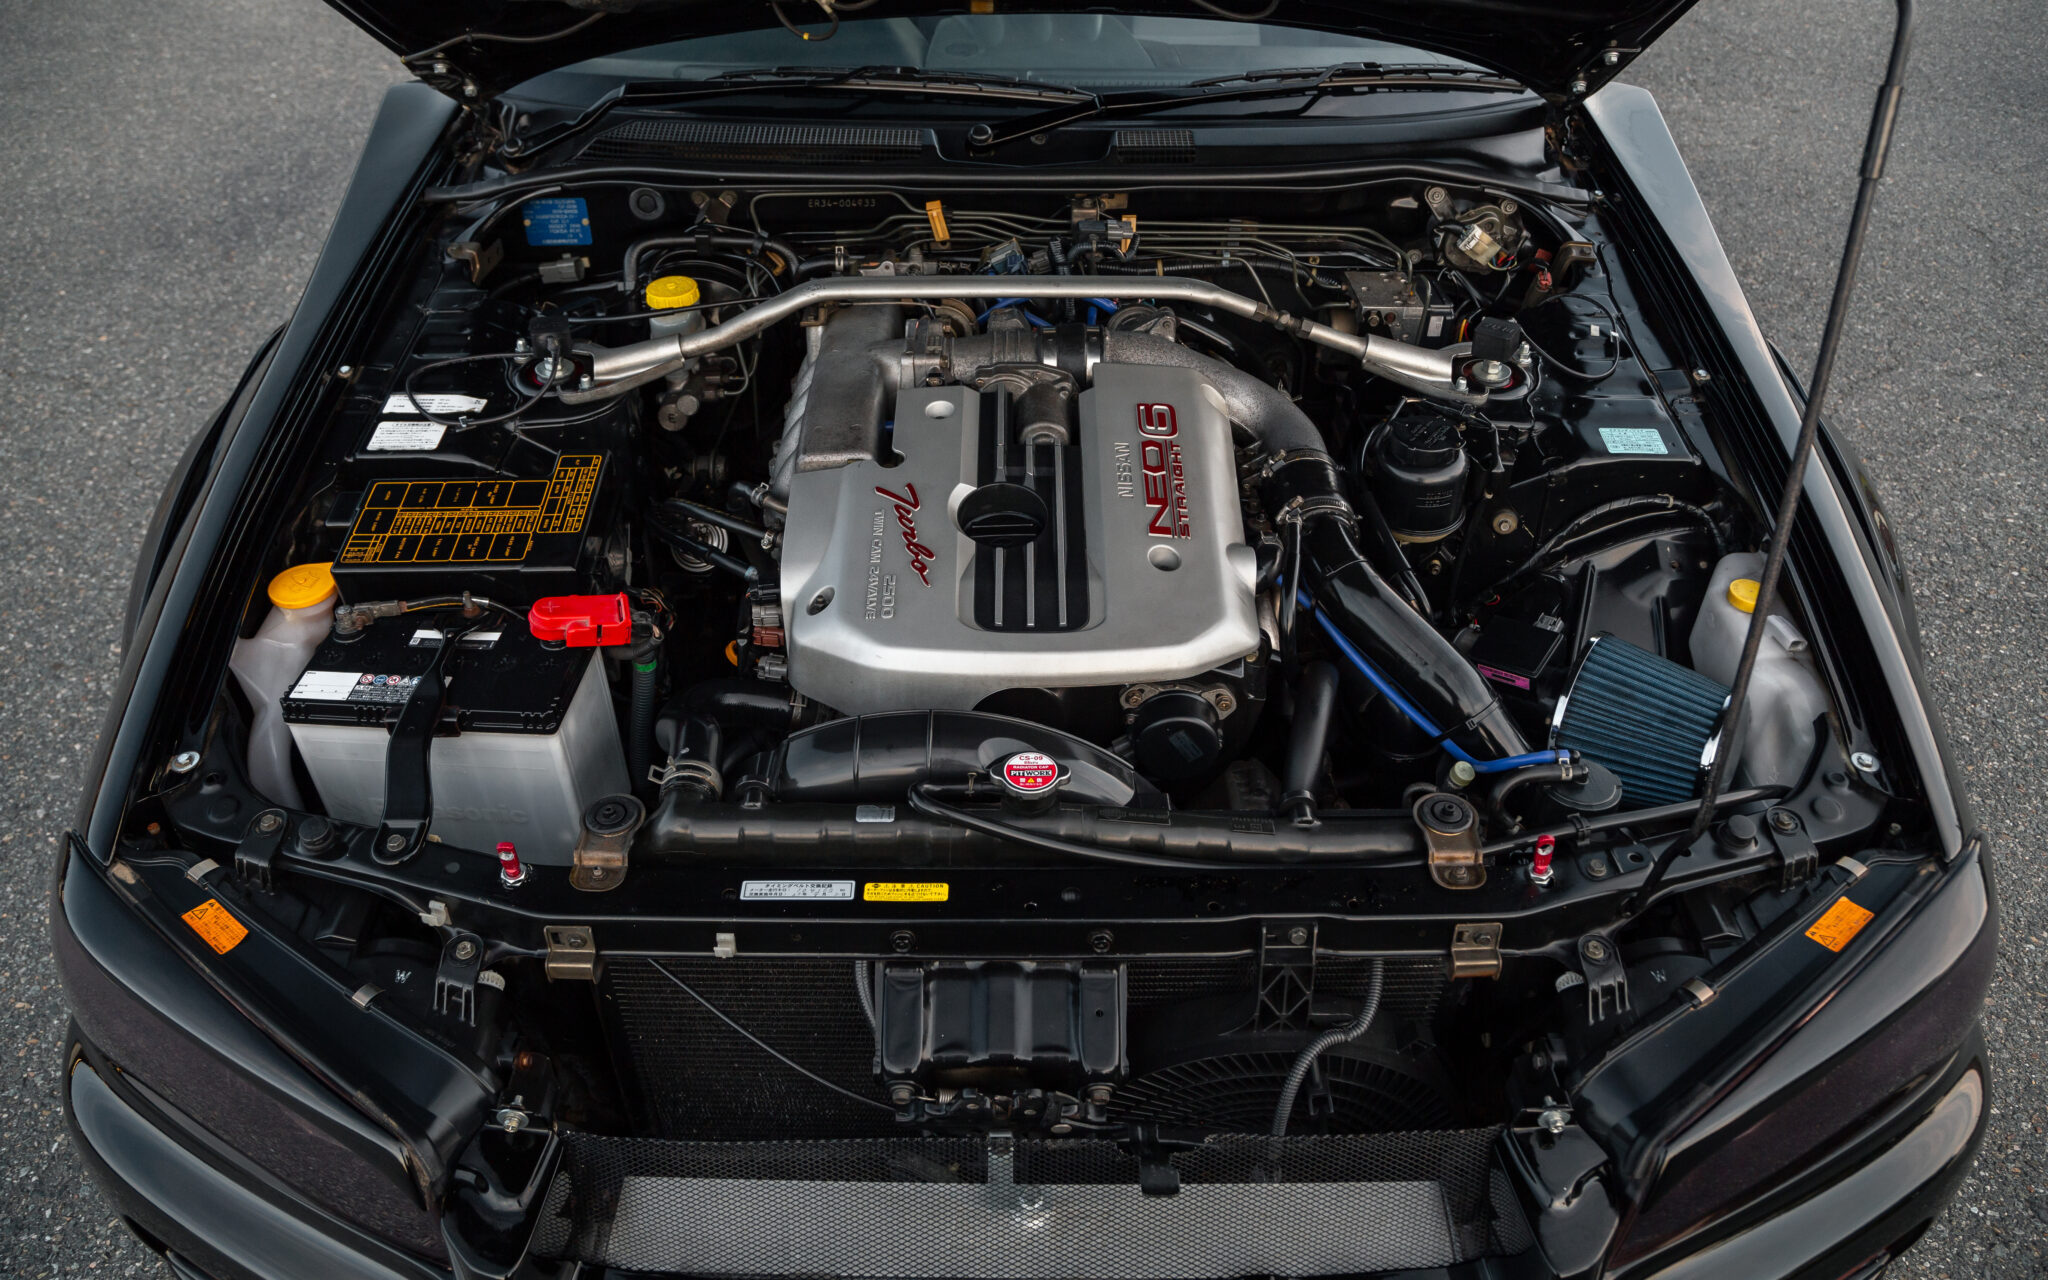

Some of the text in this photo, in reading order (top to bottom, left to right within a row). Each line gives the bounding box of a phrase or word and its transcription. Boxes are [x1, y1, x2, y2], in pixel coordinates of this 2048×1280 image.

[1114, 442, 1134, 498] NISSAN
[1169, 440, 1192, 540] STRAIGHT
[872, 510, 885, 536] TWIN
[874, 482, 936, 588] Turbo
[870, 539, 882, 563] CAM
[880, 575, 897, 620] 2500
